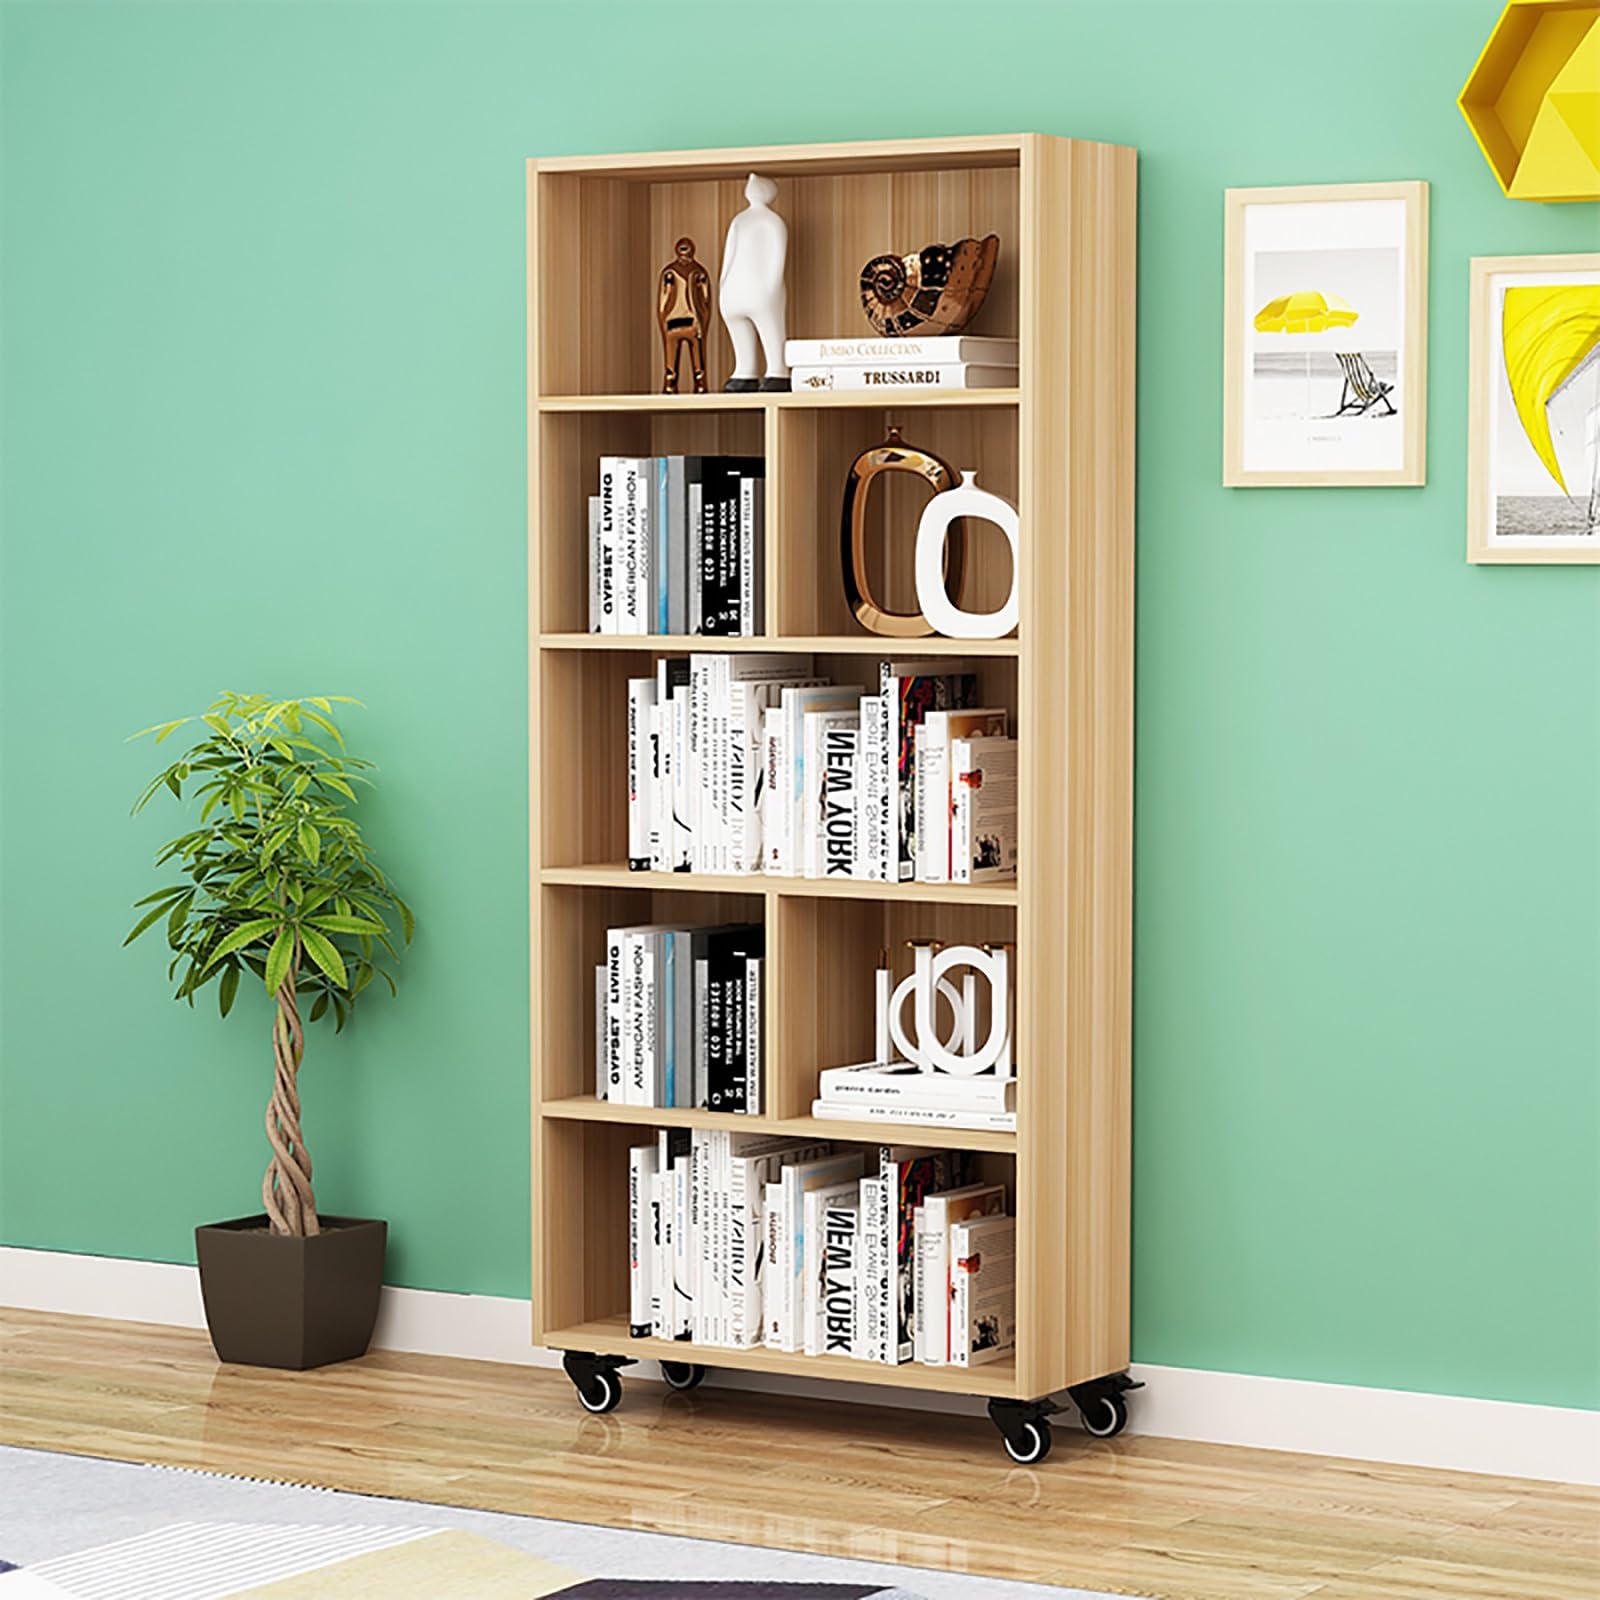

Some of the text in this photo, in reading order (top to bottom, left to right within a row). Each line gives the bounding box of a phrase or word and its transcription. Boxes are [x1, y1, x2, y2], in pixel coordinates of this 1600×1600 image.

[863, 370, 941, 385] TRUSSARDI
[603, 473, 613, 532] LIVING
[627, 470, 637, 617] AMERICAN FASHION
[704, 503, 715, 581] ECO HOUSES
[743, 558, 751, 598] WALKER
[610, 945, 620, 1085] GYPSET LIVING
[633, 945, 644, 1089] AMERICAN FASHION
